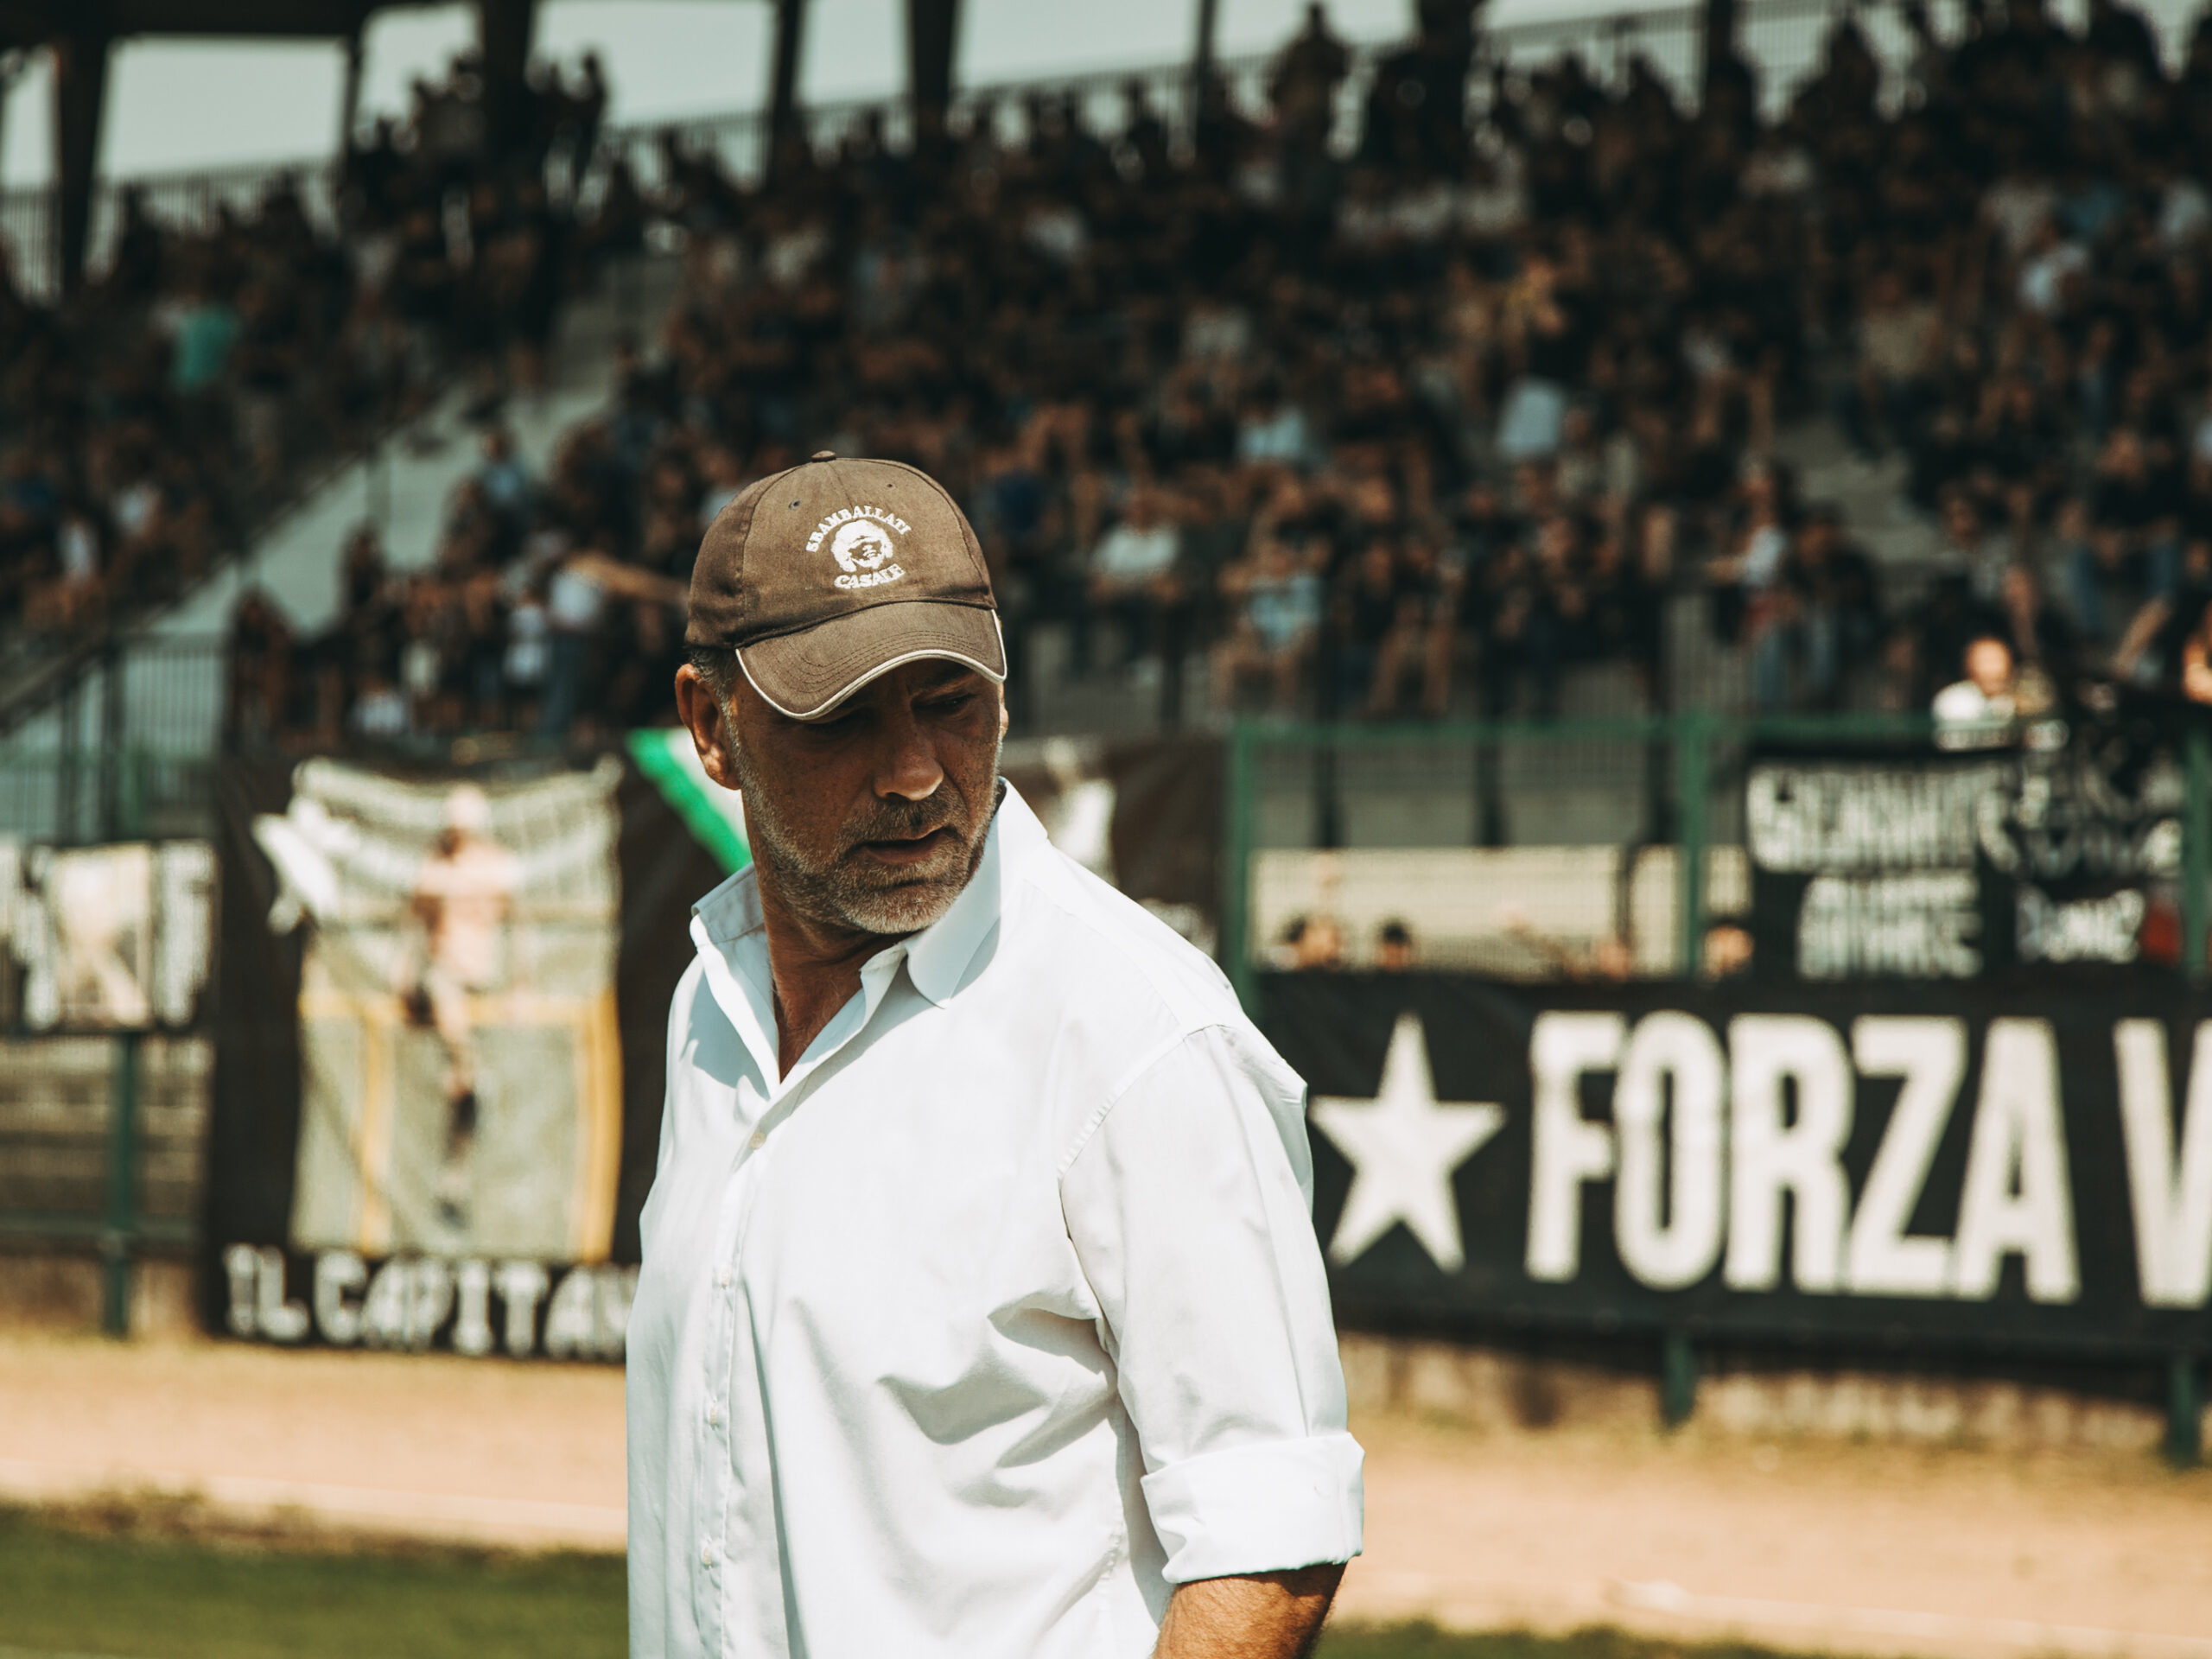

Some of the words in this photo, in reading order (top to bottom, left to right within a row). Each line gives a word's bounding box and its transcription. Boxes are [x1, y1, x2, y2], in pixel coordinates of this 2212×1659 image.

[834, 563, 906, 589] CASALE
[1526, 1010, 2080, 1303] FORZA
[222, 1243, 310, 1341] IL
